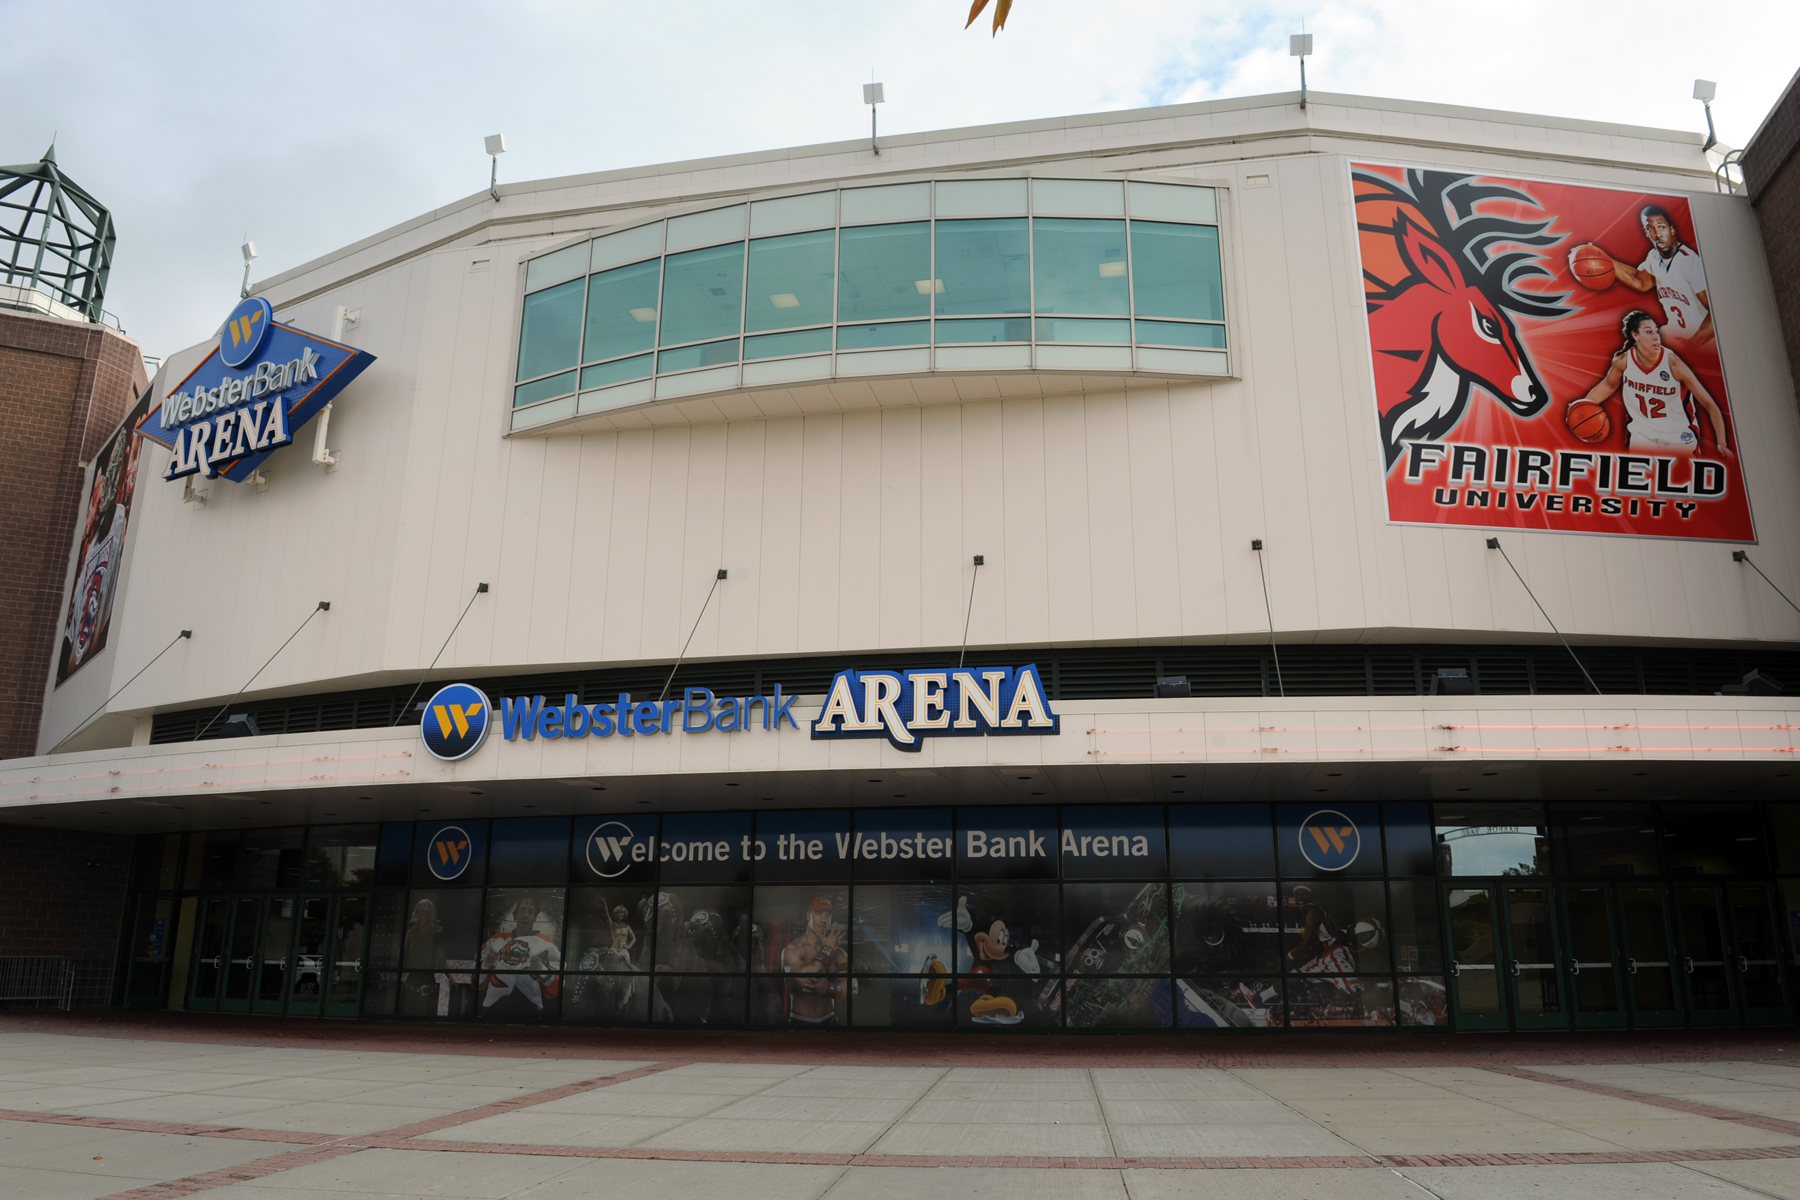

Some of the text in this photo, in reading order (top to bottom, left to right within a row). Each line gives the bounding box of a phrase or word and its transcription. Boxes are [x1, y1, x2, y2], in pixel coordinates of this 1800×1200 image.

[1670, 305, 1686, 329] 3
[1635, 393, 1667, 419] 12
[162, 395, 287, 477] ARENA
[1401, 439, 1727, 499] FAIRFIELD
[1433, 487, 1697, 519] UNIVERSITY
[815, 669, 1054, 745] ARENA
[594, 829, 1149, 863] Welcome to the Webster Bank Arena
